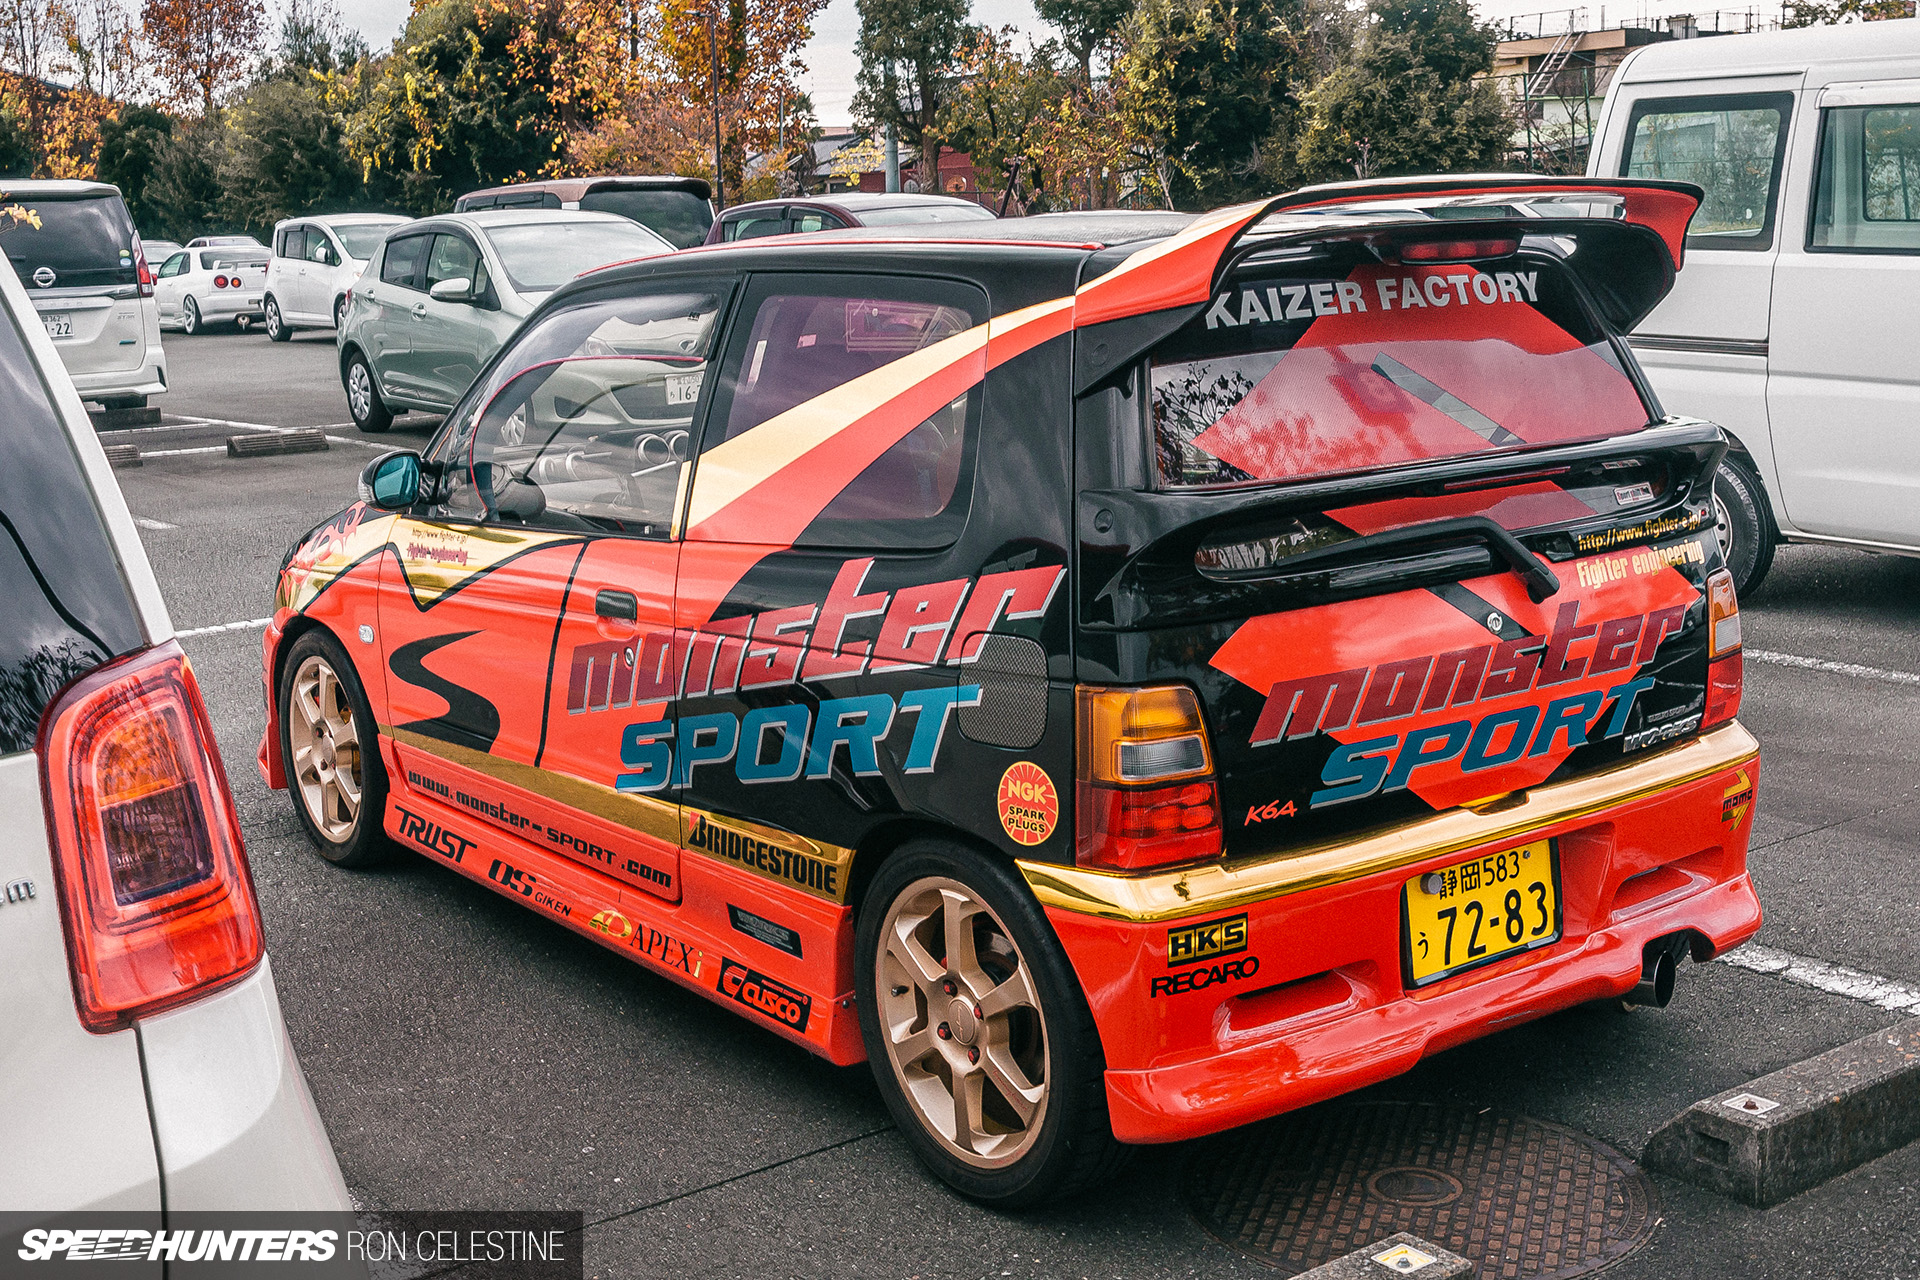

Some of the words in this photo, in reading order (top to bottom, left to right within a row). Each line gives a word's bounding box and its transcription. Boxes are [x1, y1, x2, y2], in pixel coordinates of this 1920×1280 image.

[1206, 280, 1367, 330] KAIZER
[1378, 271, 1539, 311] FACTORY
[1578, 509, 1702, 551] http://www.fighter-e.jp/
[1576, 556, 1629, 590] Fighter
[1631, 539, 1706, 576] engineering
[615, 684, 983, 793] SPORT
[1309, 677, 1655, 810] SPORT
[1007, 779, 1047, 805] NGK
[1008, 805, 1046, 822] SPARK
[1244, 800, 1298, 826] K6A
[395, 804, 478, 864] TRUST
[1008, 817, 1046, 834] PLUGS
[687, 813, 837, 896] BRIDGESTONE
[488, 858, 537, 897] OS
[534, 891, 572, 917] GIKEN
[1169, 917, 1247, 962] HKS
[1417, 931, 1429, 960] う
[1437, 881, 1548, 966] 72-83
[1150, 955, 1260, 999] RECARO
